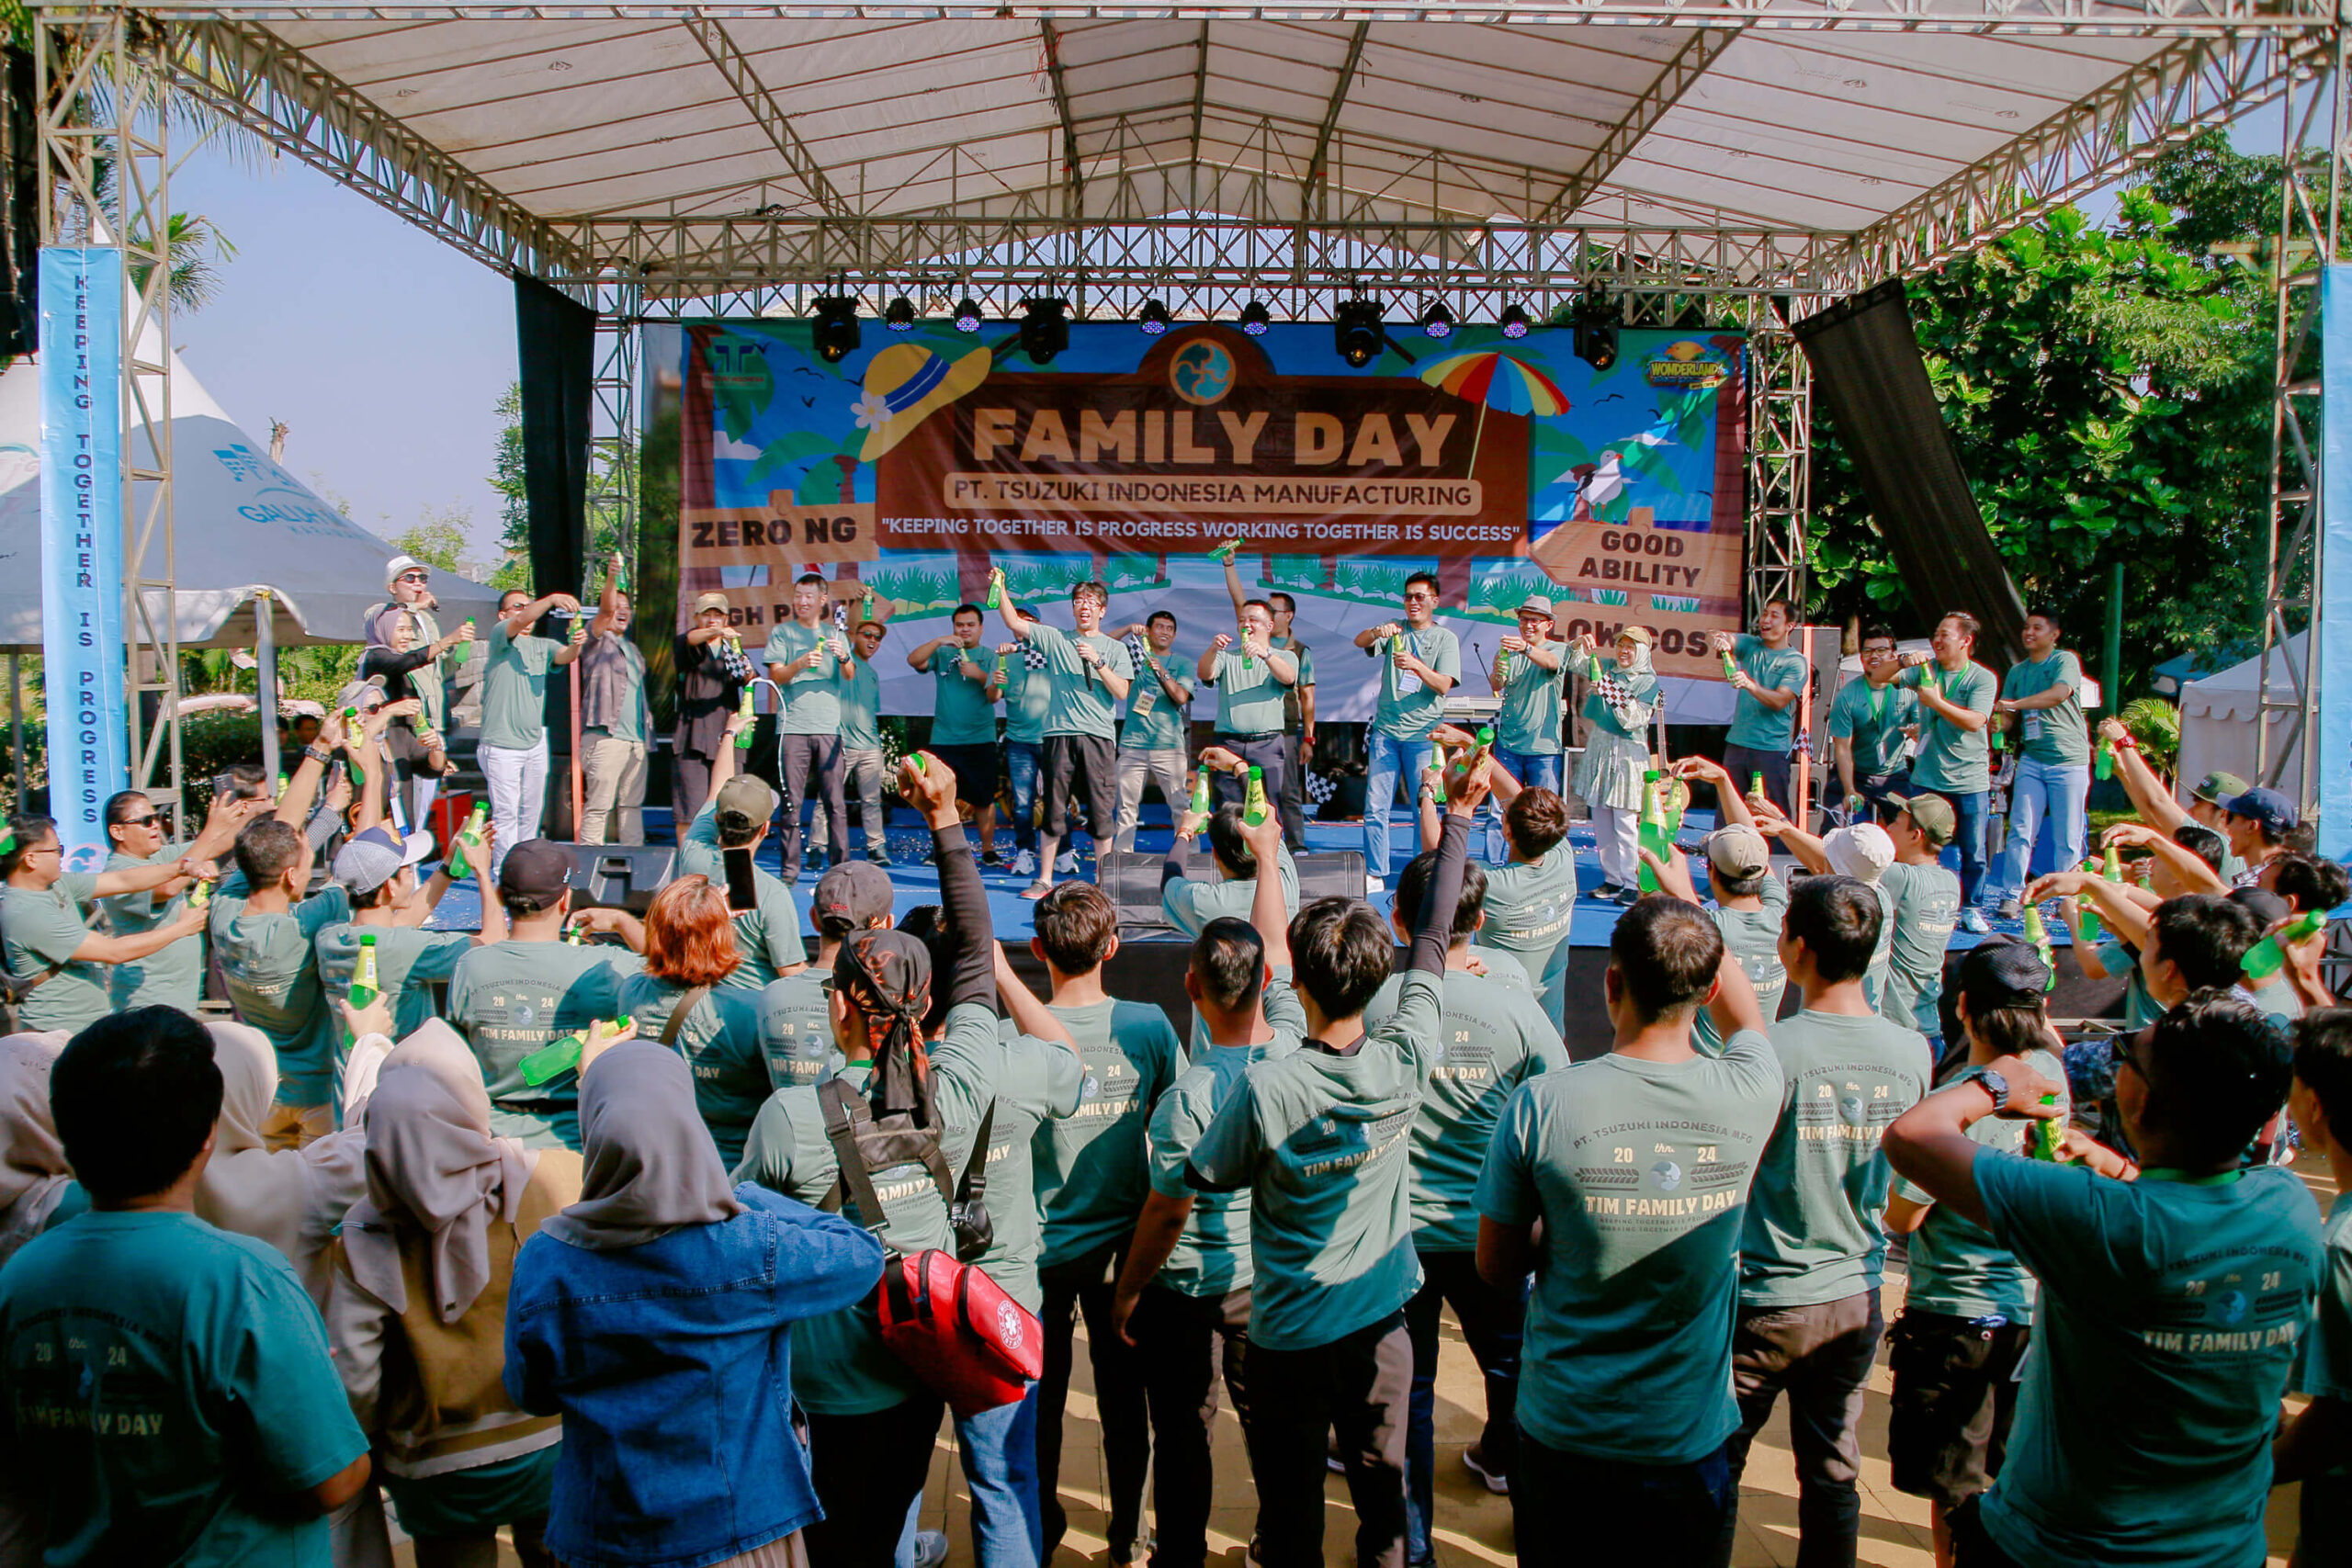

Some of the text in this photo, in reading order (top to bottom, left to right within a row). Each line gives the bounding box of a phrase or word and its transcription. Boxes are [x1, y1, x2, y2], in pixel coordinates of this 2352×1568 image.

[1650, 362, 1719, 377] WONDERLAND
[974, 408, 1457, 467] FAMILY DAY
[955, 479, 1472, 506] PT. TSUZUKI INDONESIA MANUFACTURING
[692, 516, 857, 548] ZERO NG
[882, 517, 1521, 541] "KEEPING TOGETHER IS PROGRESS WORKING TOGETHER IS SUCCESS"
[74, 275, 97, 823] KEEPING TOGETHER IS PROGRESS
[1601, 530, 1684, 558] GOOD
[1577, 557, 1702, 587] ABILITY
[541, 998, 554, 1009] 24
[480, 1027, 499, 1041] TIM
[501, 1028, 545, 1042] FAMILY
[782, 1023, 794, 1035] 20
[1454, 1031, 1469, 1043] 24
[695, 1066, 719, 1078] DAY
[1107, 1065, 1121, 1077] 24
[1459, 1066, 1487, 1079] DAY
[1804, 1065, 1845, 1079] TSUZUKI
[1848, 1064, 1896, 1077] INDONESIA
[1818, 1084, 1831, 1098] 20
[1874, 1085, 1888, 1099] 24
[1072, 1099, 1140, 1118] AMILY DAY
[1323, 1119, 1336, 1135] 20
[1574, 1120, 1754, 1150] PT. TSUZUKI INDONESIA MFG
[1797, 1125, 1824, 1140] TIM
[1826, 1123, 1873, 1140] FAMILY
[1614, 1147, 1634, 1164] 20
[1697, 1146, 1716, 1163] 24
[1303, 1160, 1330, 1178] TIM
[877, 1179, 926, 1202] AMILY
[1585, 1190, 1737, 1216] TIM FAMILY DAY
[2261, 1271, 2280, 1291] 24
[2143, 1330, 2183, 1352] TIM
[2188, 1330, 2262, 1352] FAMILY
[107, 1346, 127, 1366] 24
[117, 1414, 164, 1435] DAY
